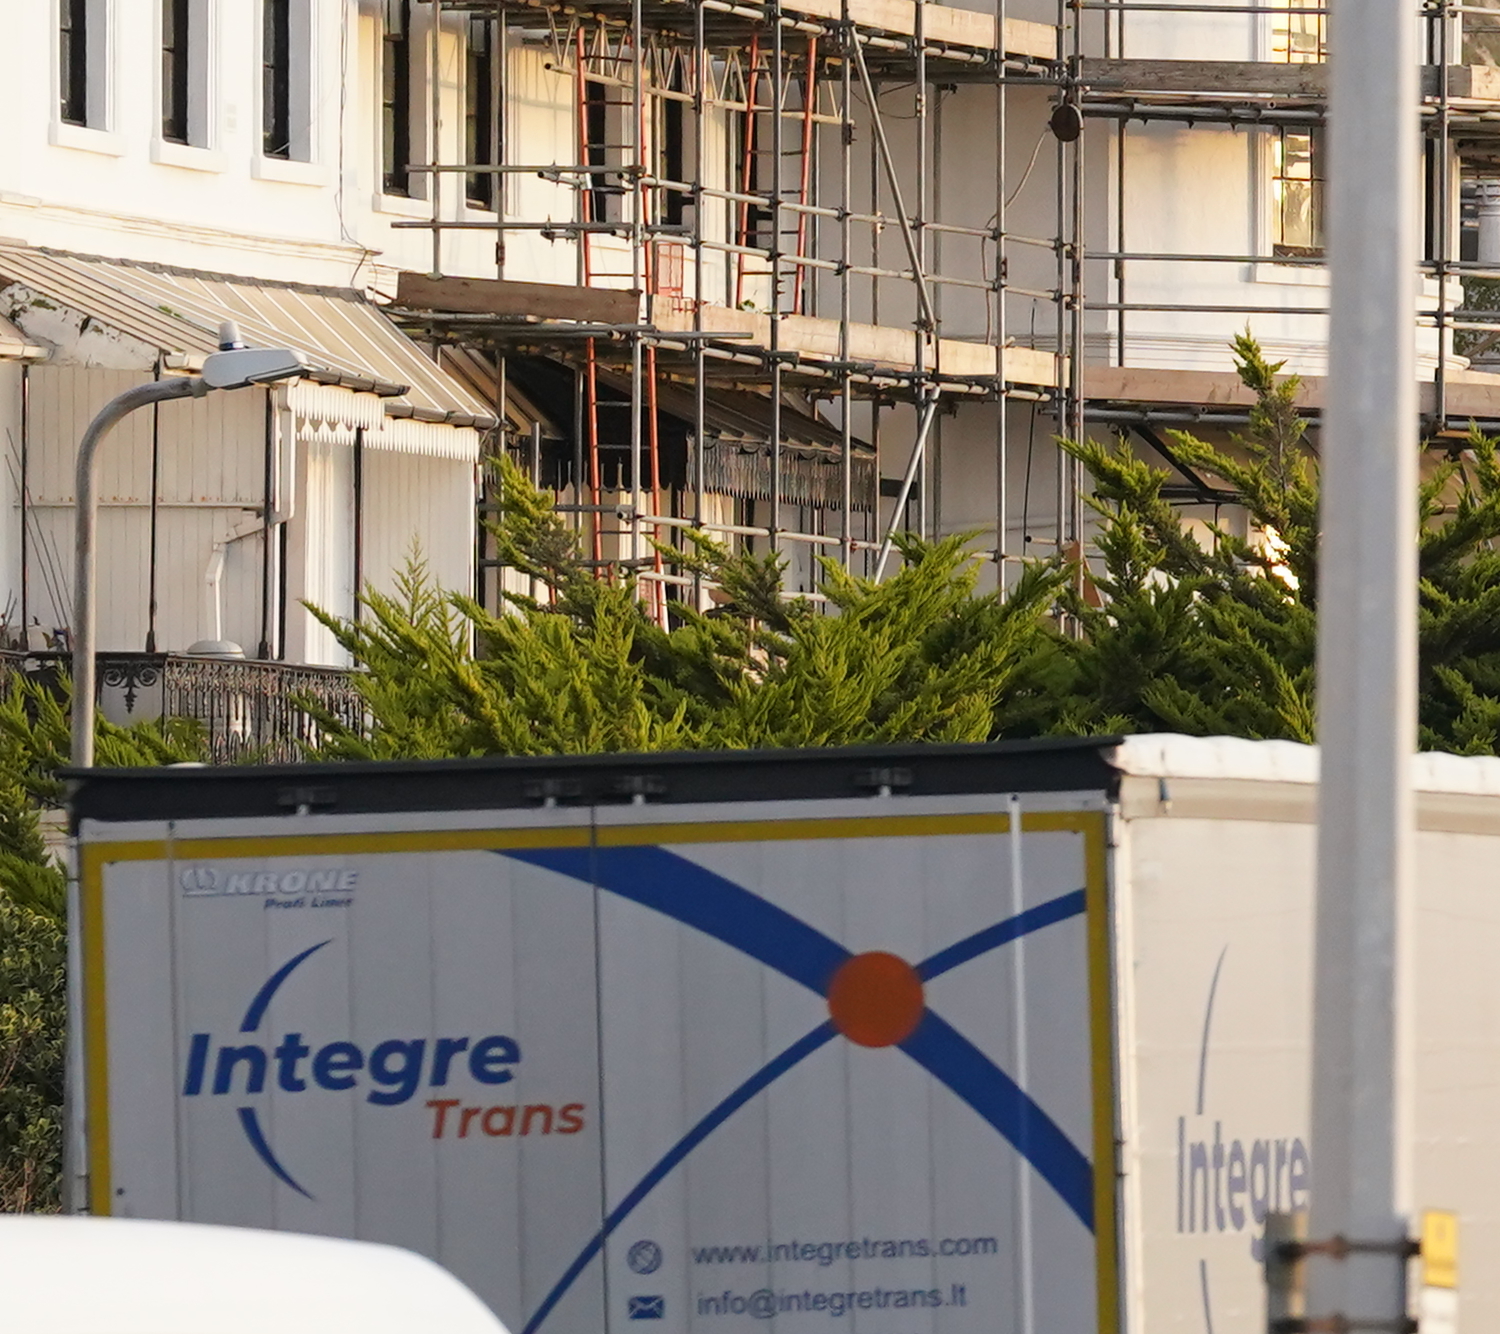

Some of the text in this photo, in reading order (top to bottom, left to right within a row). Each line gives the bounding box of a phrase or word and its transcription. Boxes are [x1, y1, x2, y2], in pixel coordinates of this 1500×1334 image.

[226, 869, 358, 895] KRONE
[183, 1033, 520, 1106] Integre
[425, 1098, 586, 1139] Trans
[690, 1235, 998, 1265] www.integretrans.com
[698, 1283, 967, 1319] info@integretrans.lt
